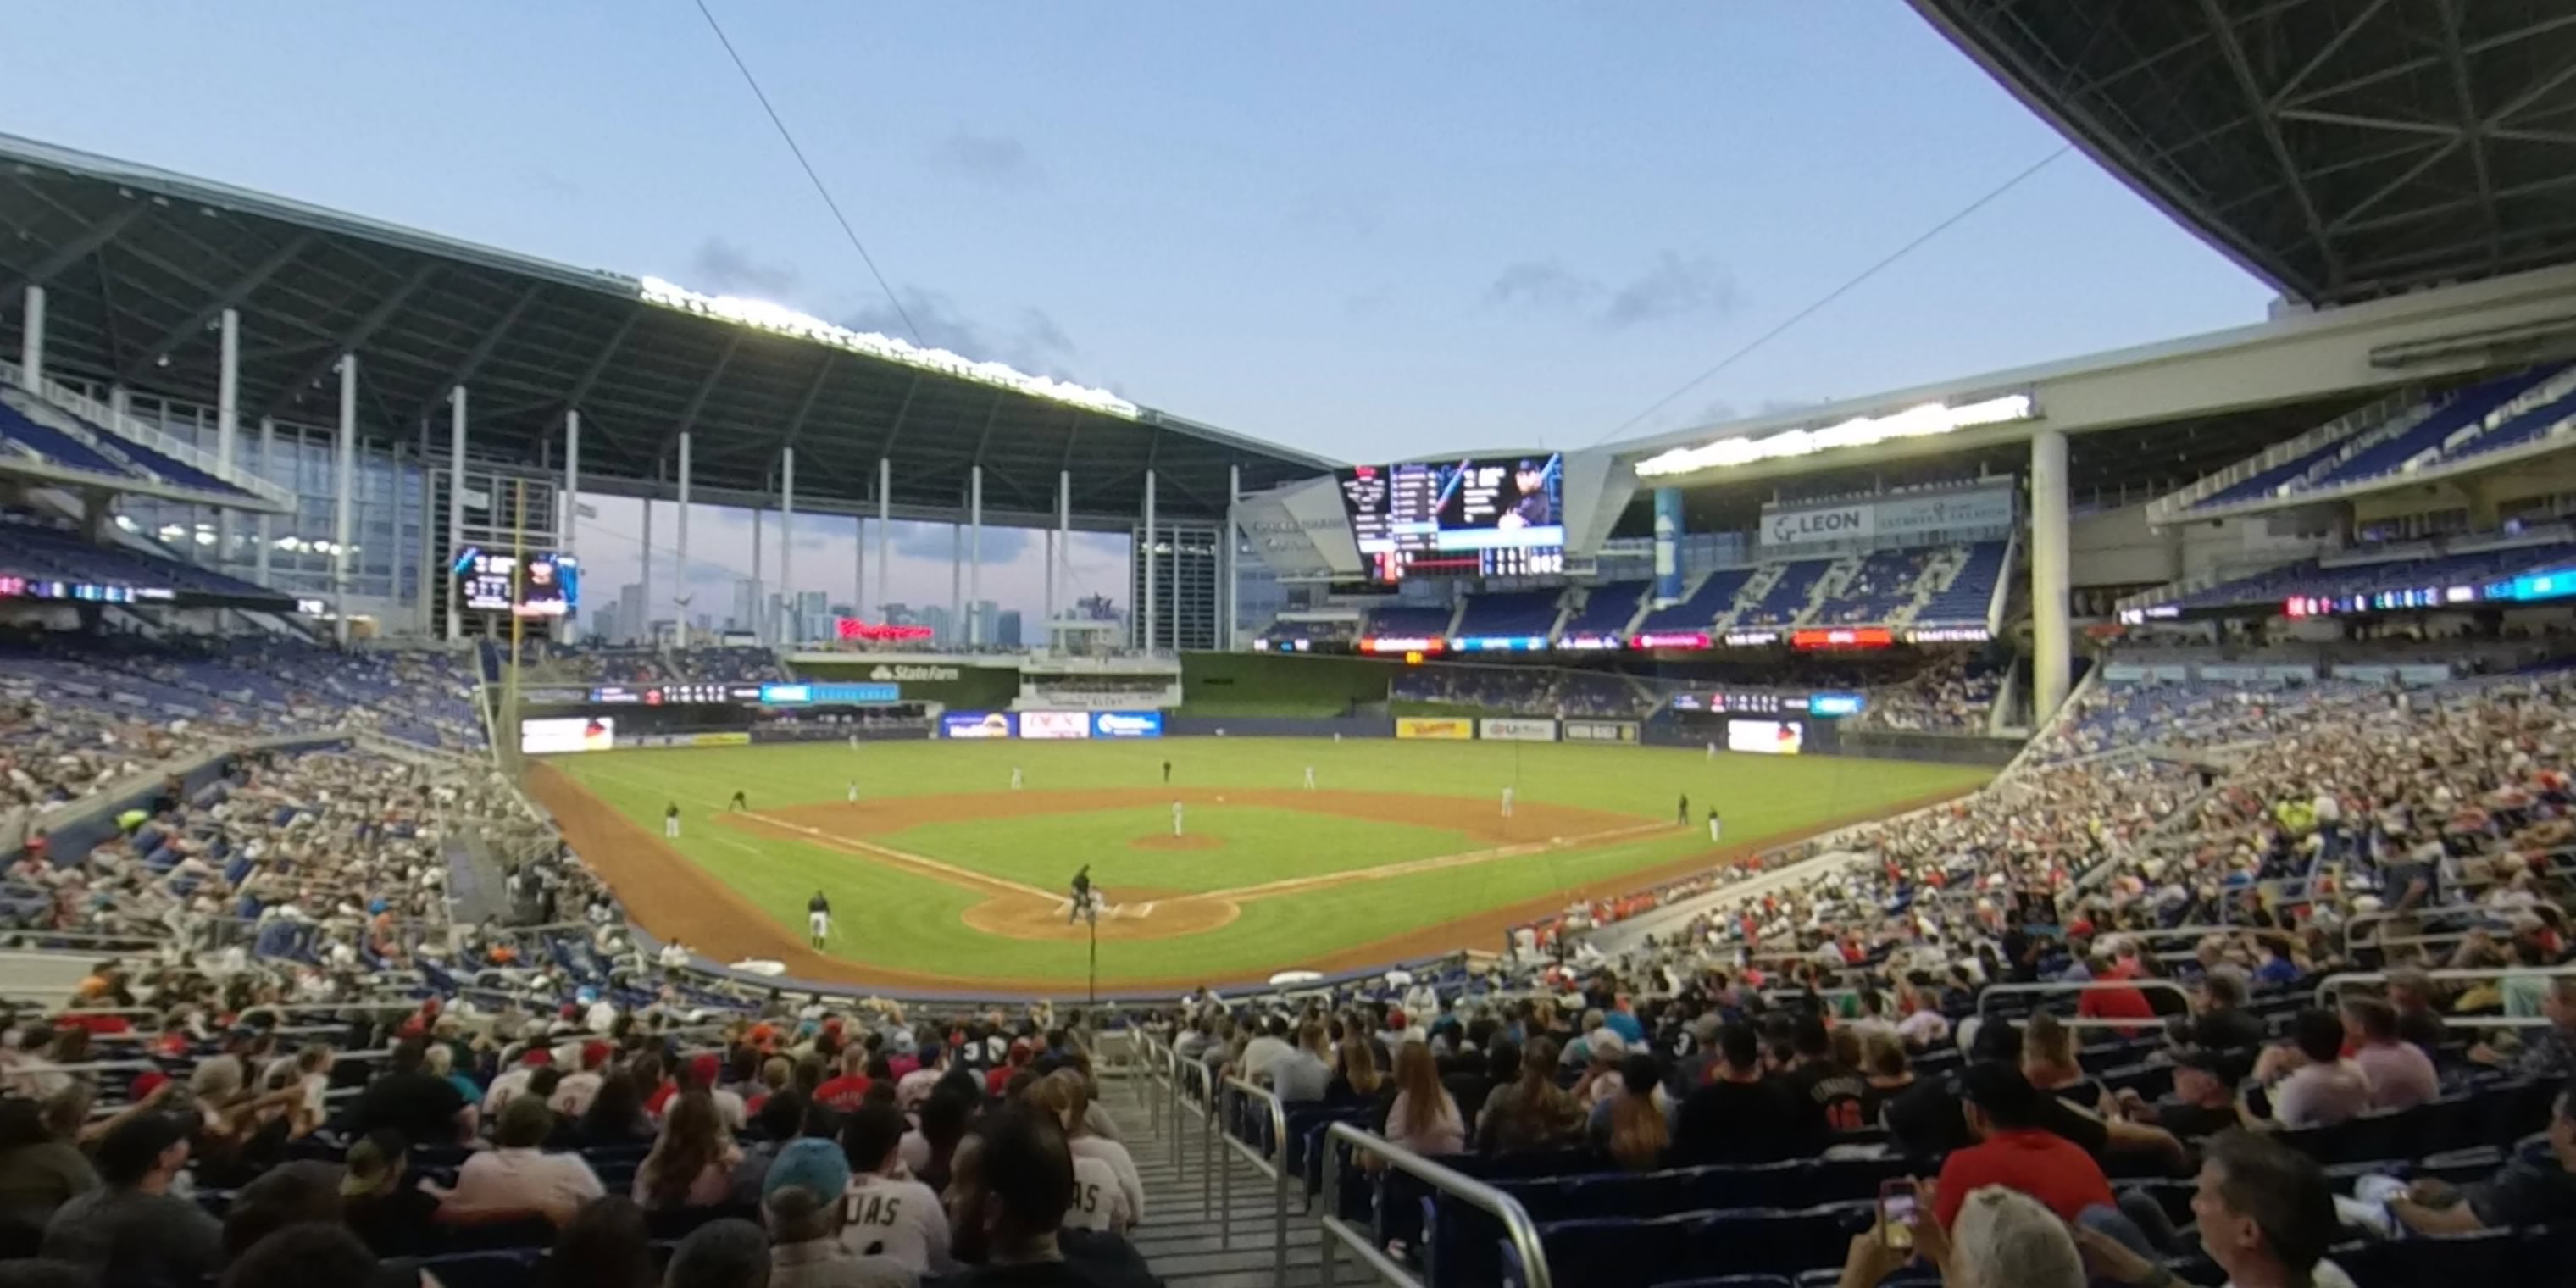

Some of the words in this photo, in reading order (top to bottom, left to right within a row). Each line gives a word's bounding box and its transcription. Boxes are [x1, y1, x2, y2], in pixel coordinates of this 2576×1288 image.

[1799, 510, 1860, 533] LEON
[894, 665, 929, 681] State
[929, 665, 958, 680] Farm
